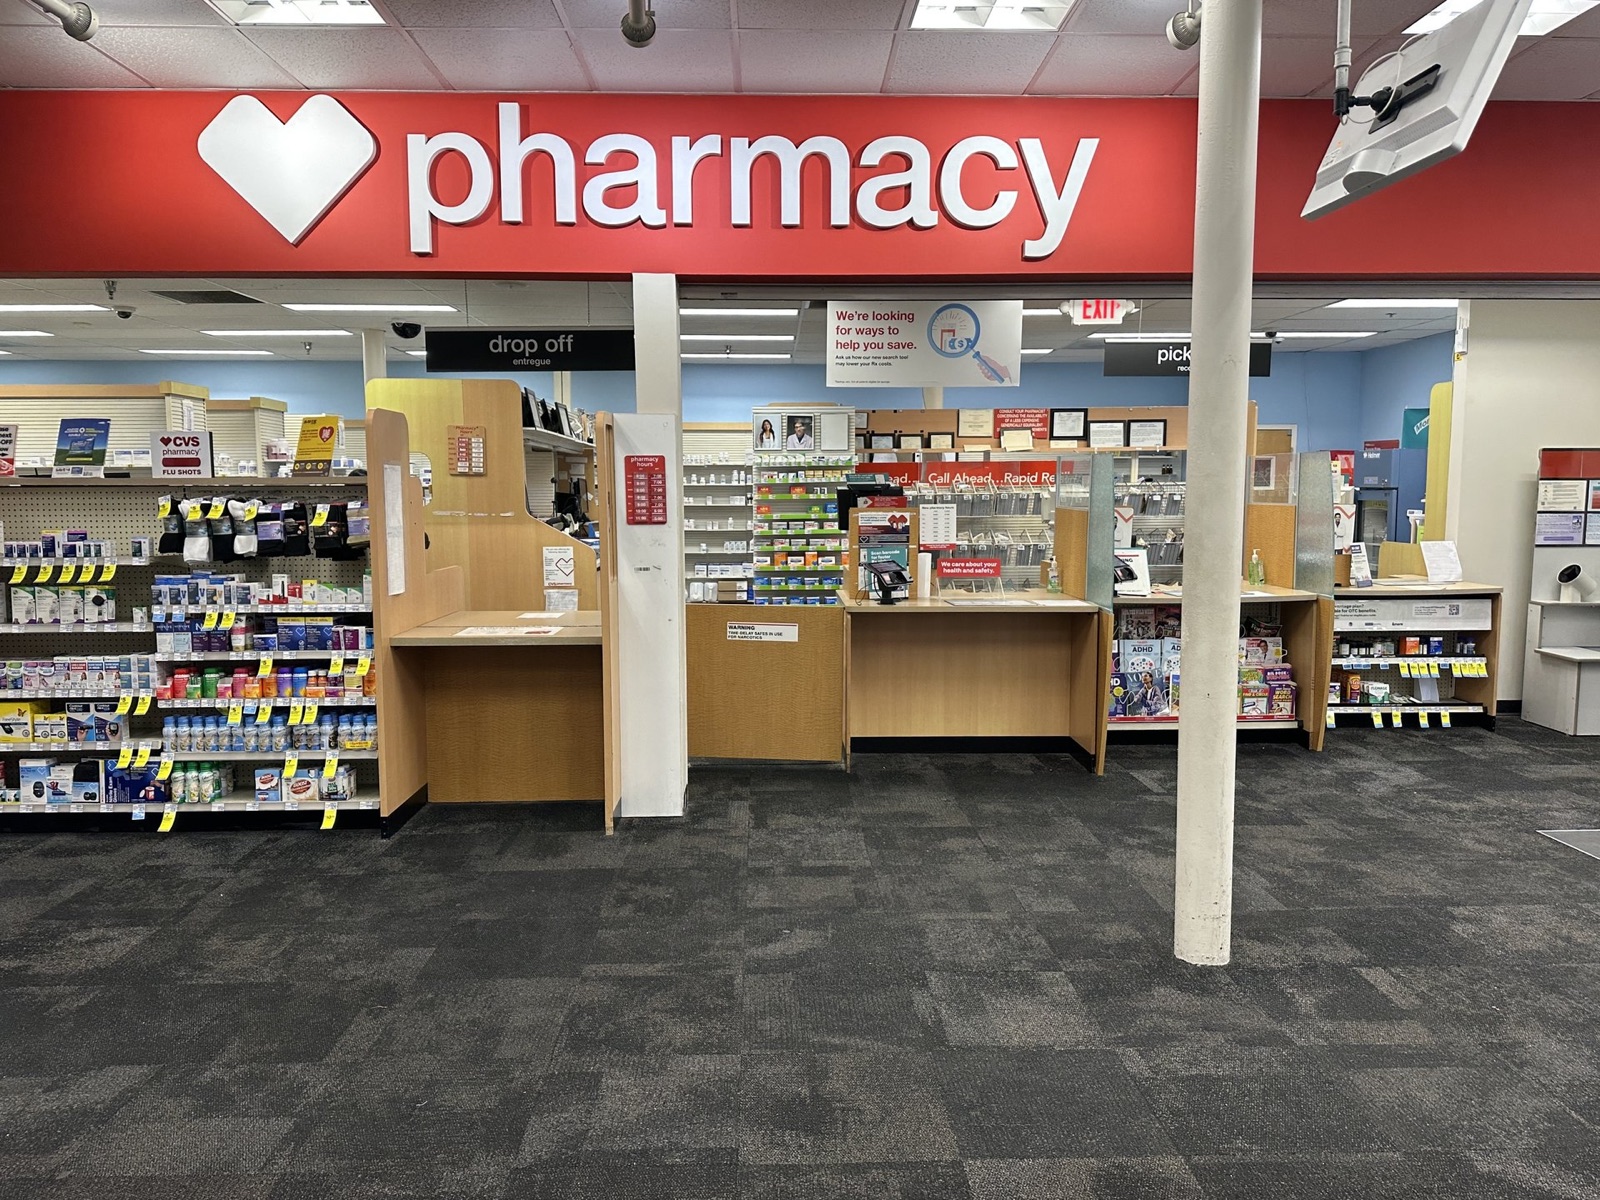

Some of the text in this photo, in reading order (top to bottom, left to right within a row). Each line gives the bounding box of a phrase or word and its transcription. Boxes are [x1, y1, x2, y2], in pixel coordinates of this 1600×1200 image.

[406, 101, 1100, 262] pharmacy
[1082, 299, 1116, 319] EXIT
[836, 310, 915, 323] We're looking
[835, 325, 900, 338] for ways to
[489, 334, 574, 357] drop off
[835, 340, 917, 352] help you save.
[1157, 345, 1191, 364] pick
[512, 357, 551, 367] entregue
[172, 436, 200, 447] CVS
[162, 448, 200, 457] pharmacy
[928, 472, 951, 484] Call
[1004, 473, 1040, 487] Rapid
